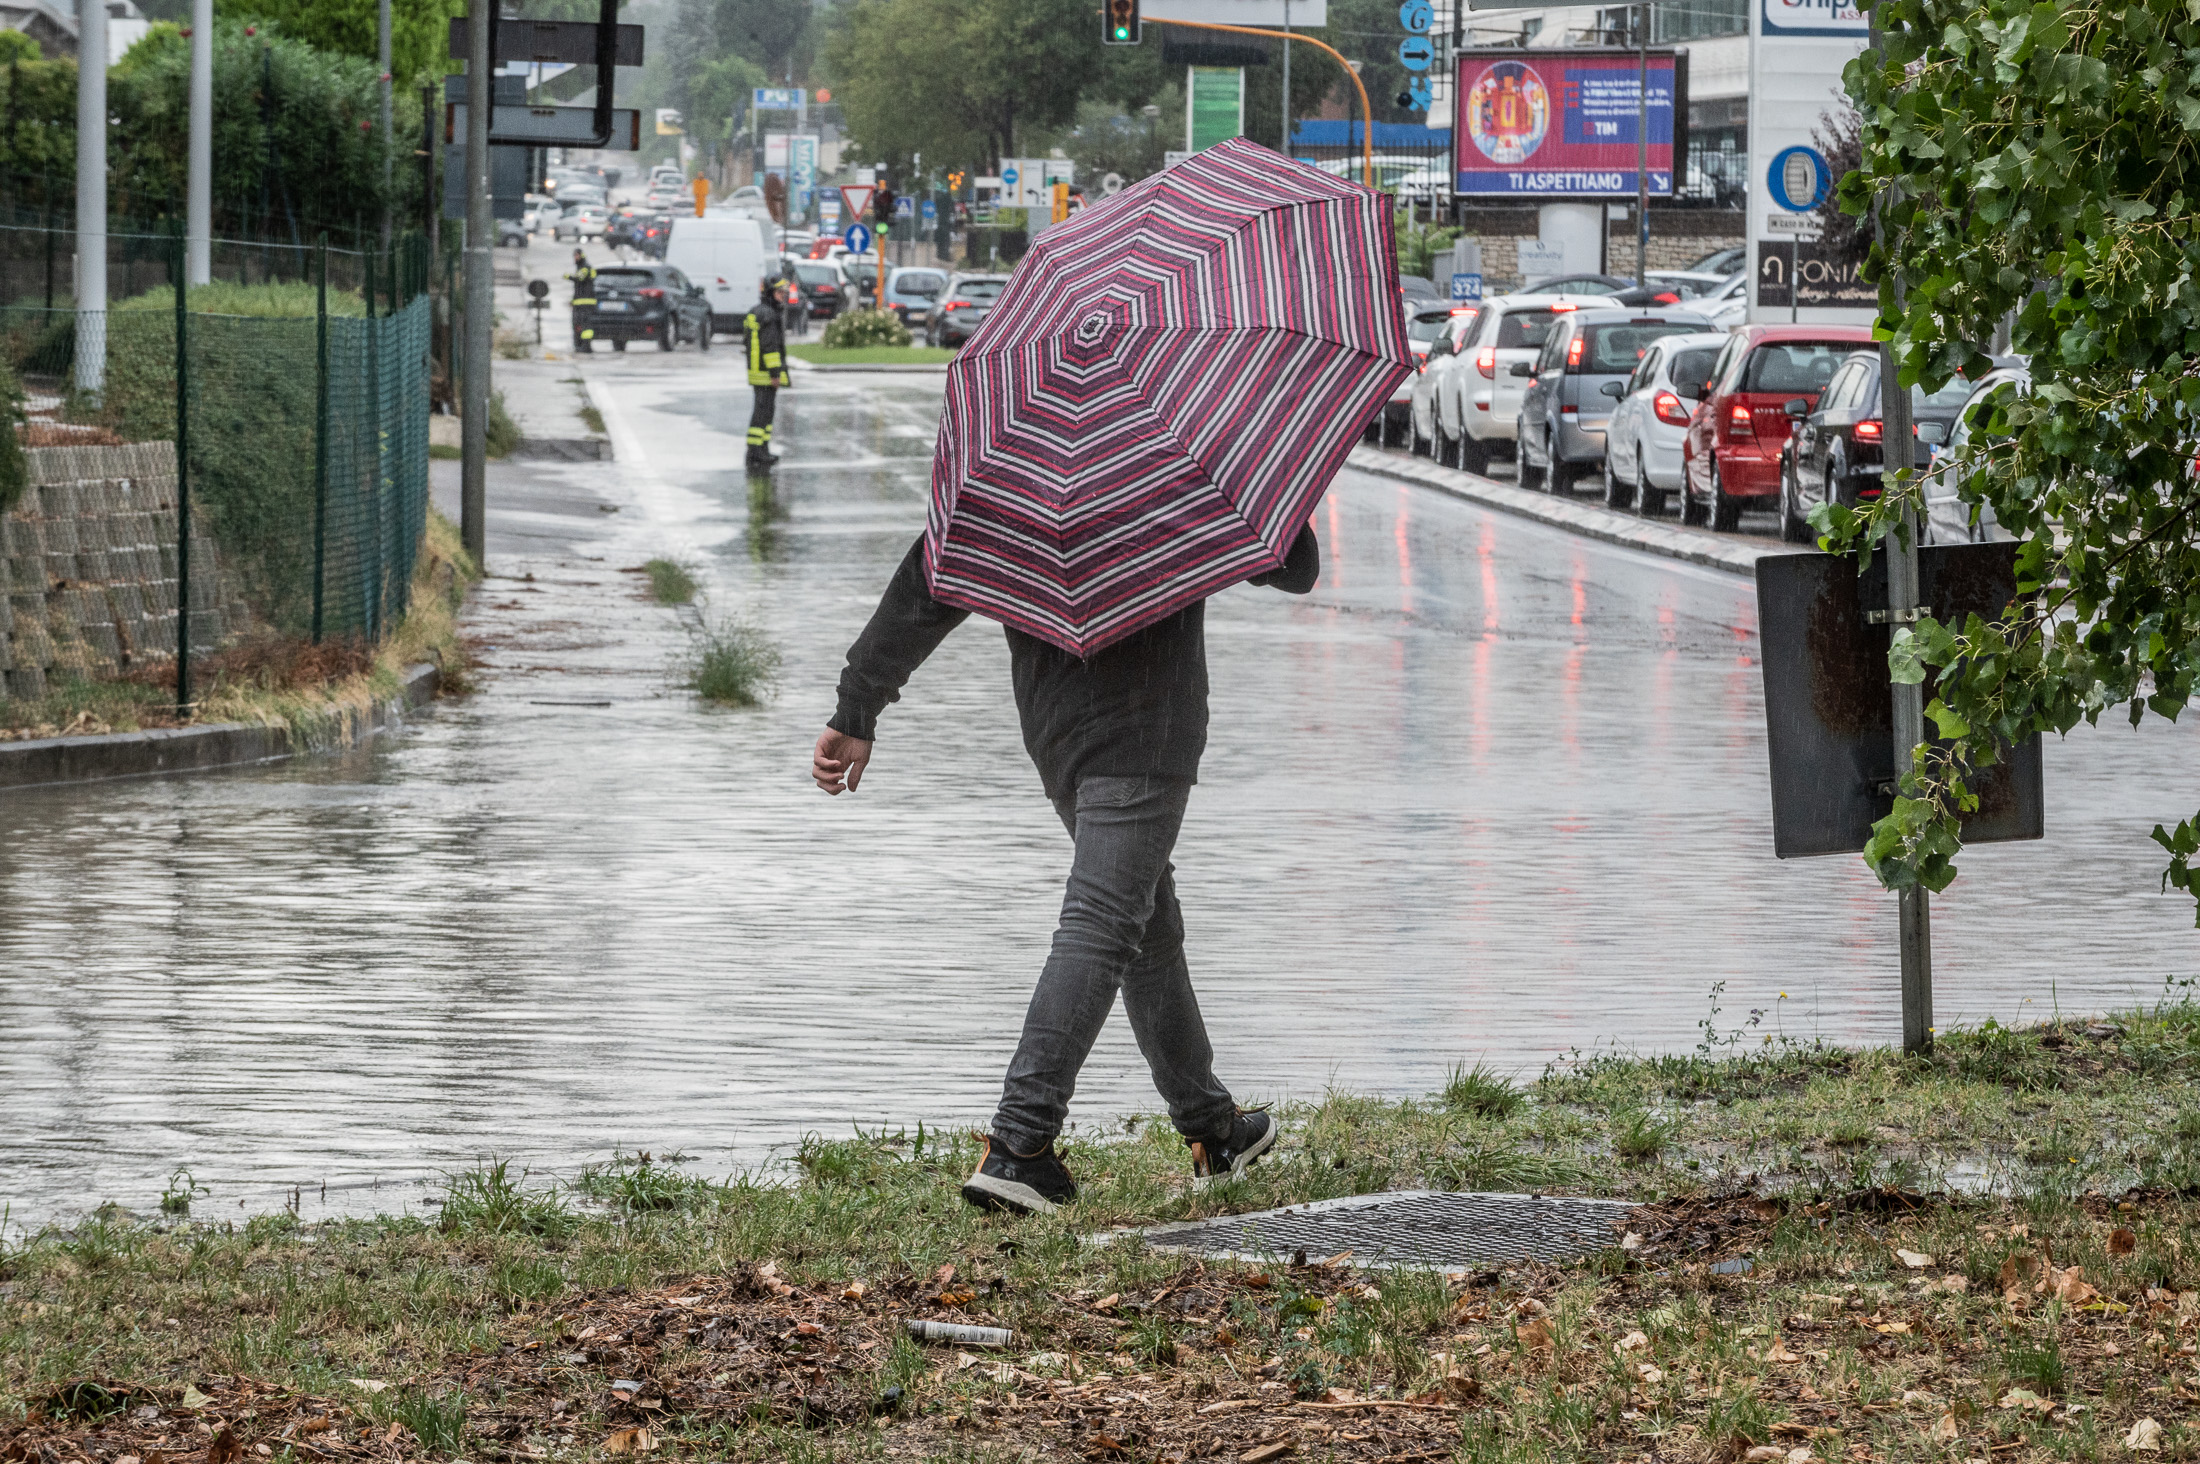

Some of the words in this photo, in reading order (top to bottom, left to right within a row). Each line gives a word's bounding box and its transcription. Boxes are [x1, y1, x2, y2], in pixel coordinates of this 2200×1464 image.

[1594, 121, 1618, 136] TIM
[1508, 173, 1523, 190] TI
[1525, 173, 1623, 190] ASPETTIAMO
[1519, 251, 1562, 260] creativity
[1453, 282, 1480, 296] 324
